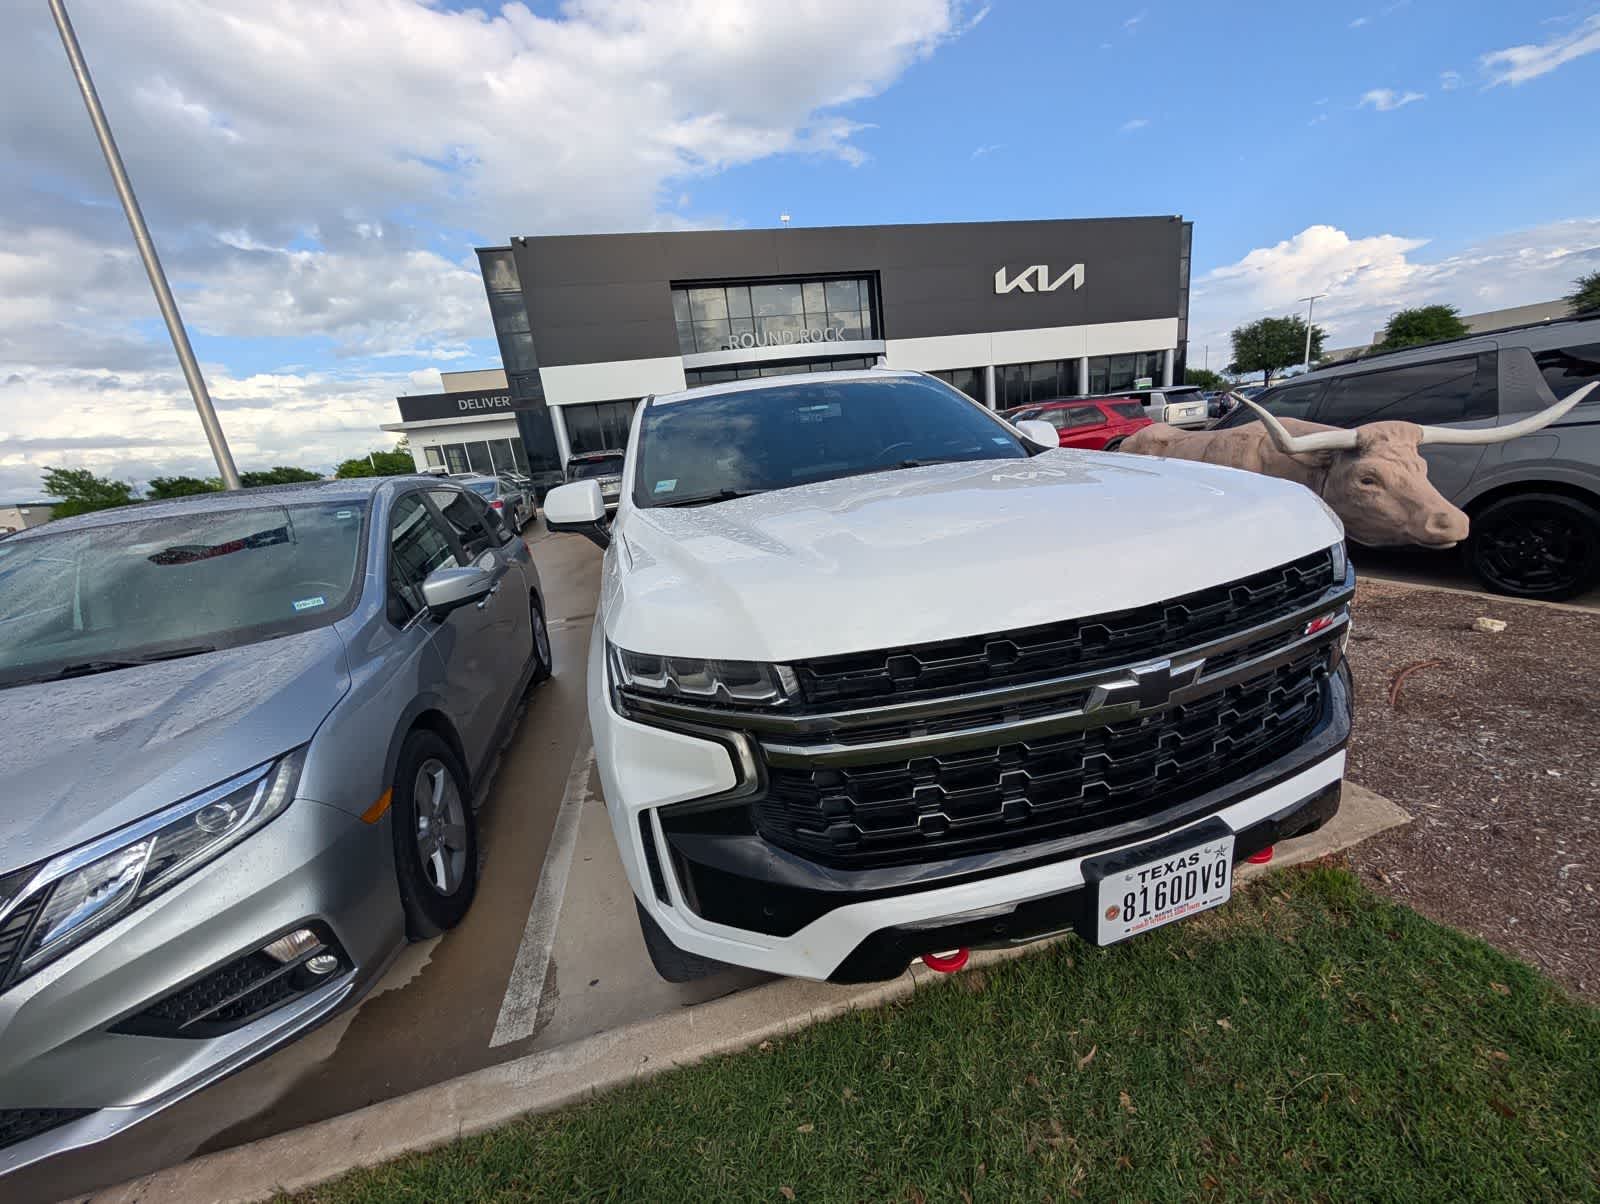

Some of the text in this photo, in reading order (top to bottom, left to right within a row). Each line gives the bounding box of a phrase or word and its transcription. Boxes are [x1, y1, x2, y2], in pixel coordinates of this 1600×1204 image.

[995, 263, 1085, 294] KIA
[728, 327, 846, 350] ROUND ROCK
[458, 395, 511, 410] DELIVER
[1138, 853, 1200, 884] TEXAS
